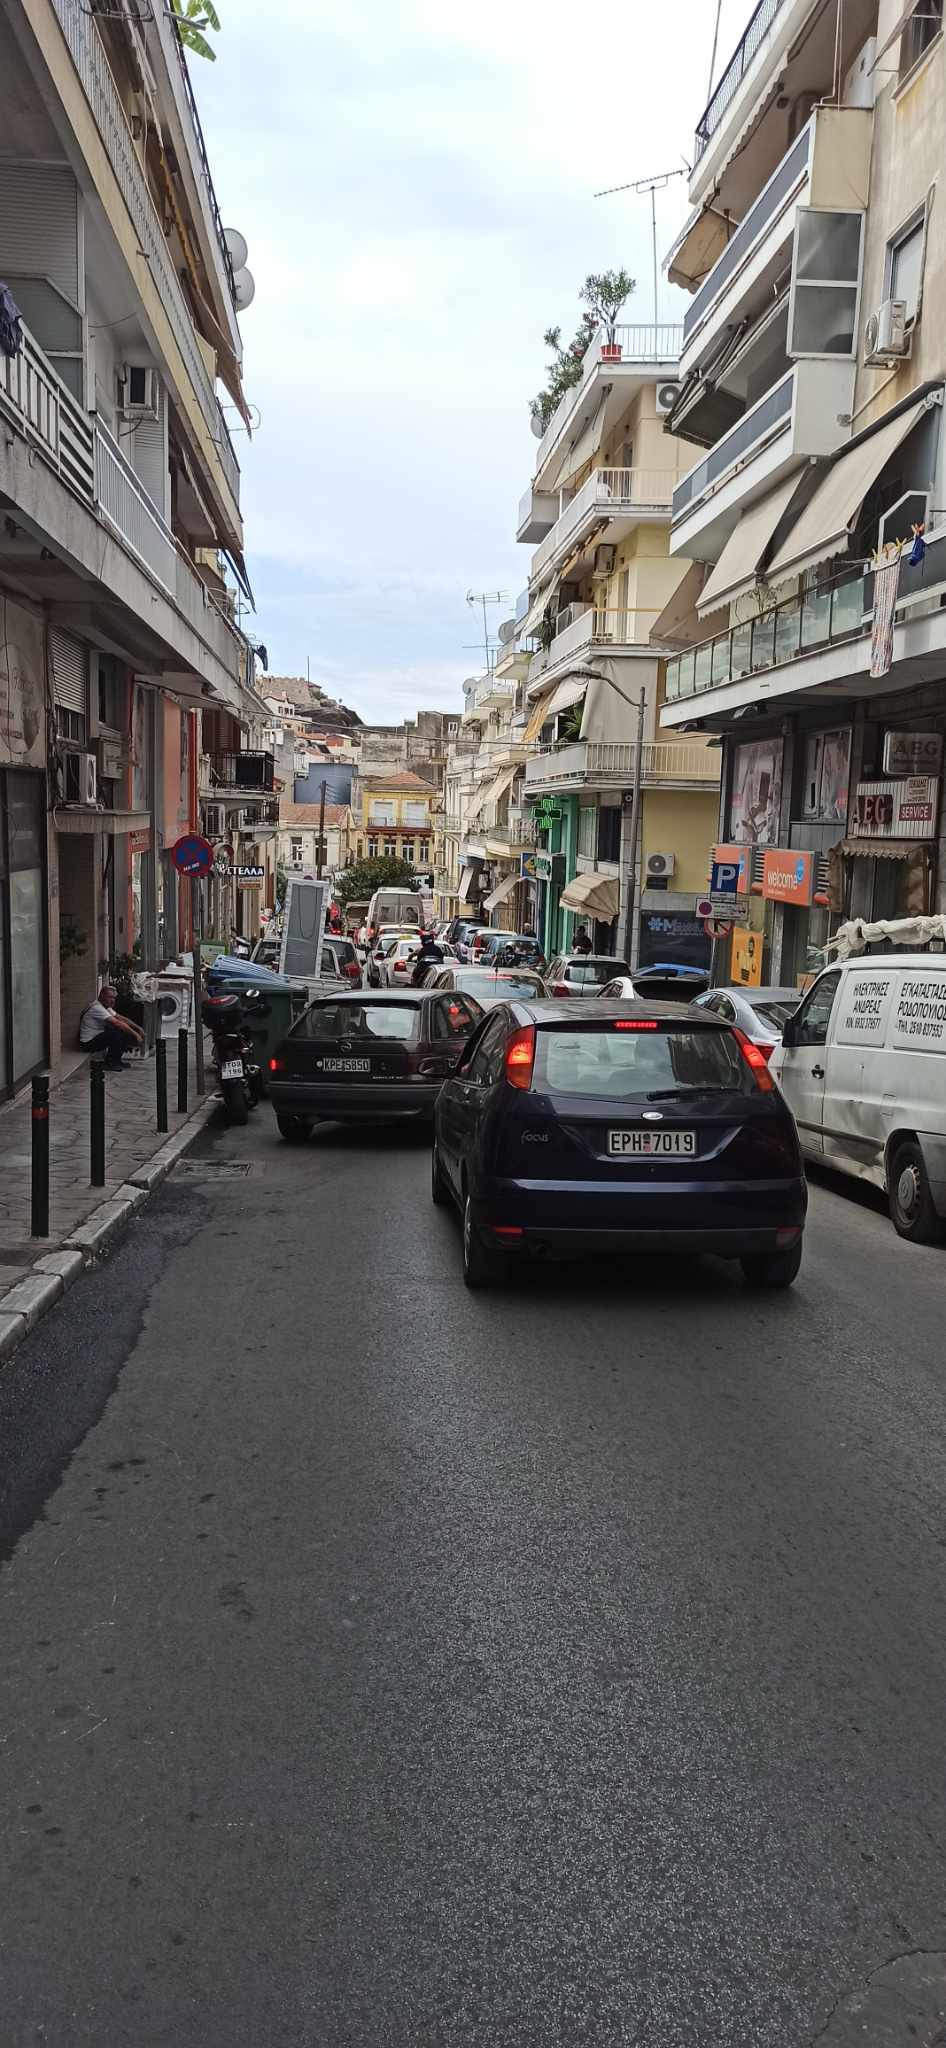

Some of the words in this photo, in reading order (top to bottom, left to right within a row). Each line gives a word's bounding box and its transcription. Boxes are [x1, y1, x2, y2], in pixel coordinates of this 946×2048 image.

[901, 806, 929, 819] SERVICE
[716, 865, 736, 889] P
[767, 868, 798, 889] welcome
[853, 1000, 882, 1014] ΑΝΔΡΕΑΣ
[653, 1133, 693, 1151] 7019
